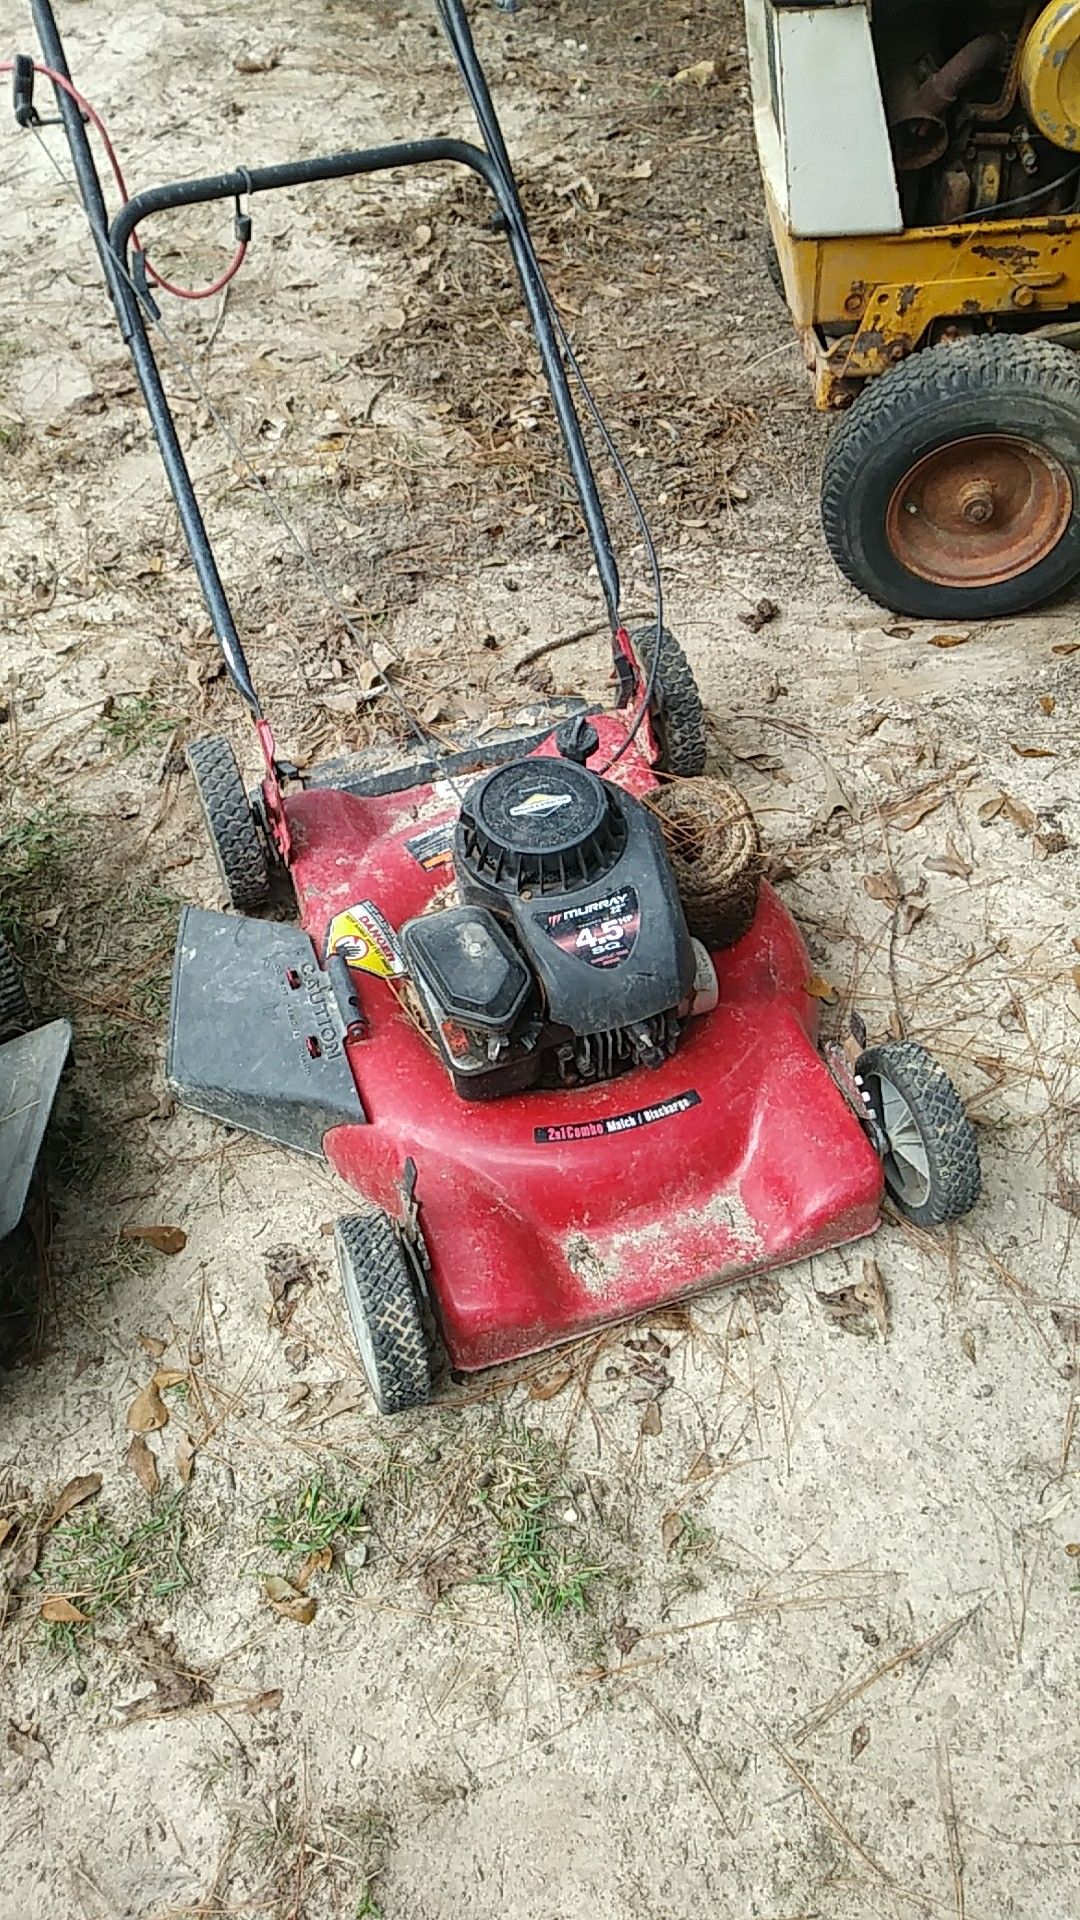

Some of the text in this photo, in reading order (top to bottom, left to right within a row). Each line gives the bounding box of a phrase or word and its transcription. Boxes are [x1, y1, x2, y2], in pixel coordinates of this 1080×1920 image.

[563, 893, 628, 920] MURRAY
[359, 915, 396, 962] DANGER
[575, 919, 624, 948] 4.5
[591, 941, 623, 955] SQ
[301, 963, 342, 1060] CAUTION
[606, 1115, 637, 1134] Mulch
[643, 1098, 690, 1122] Discharge
